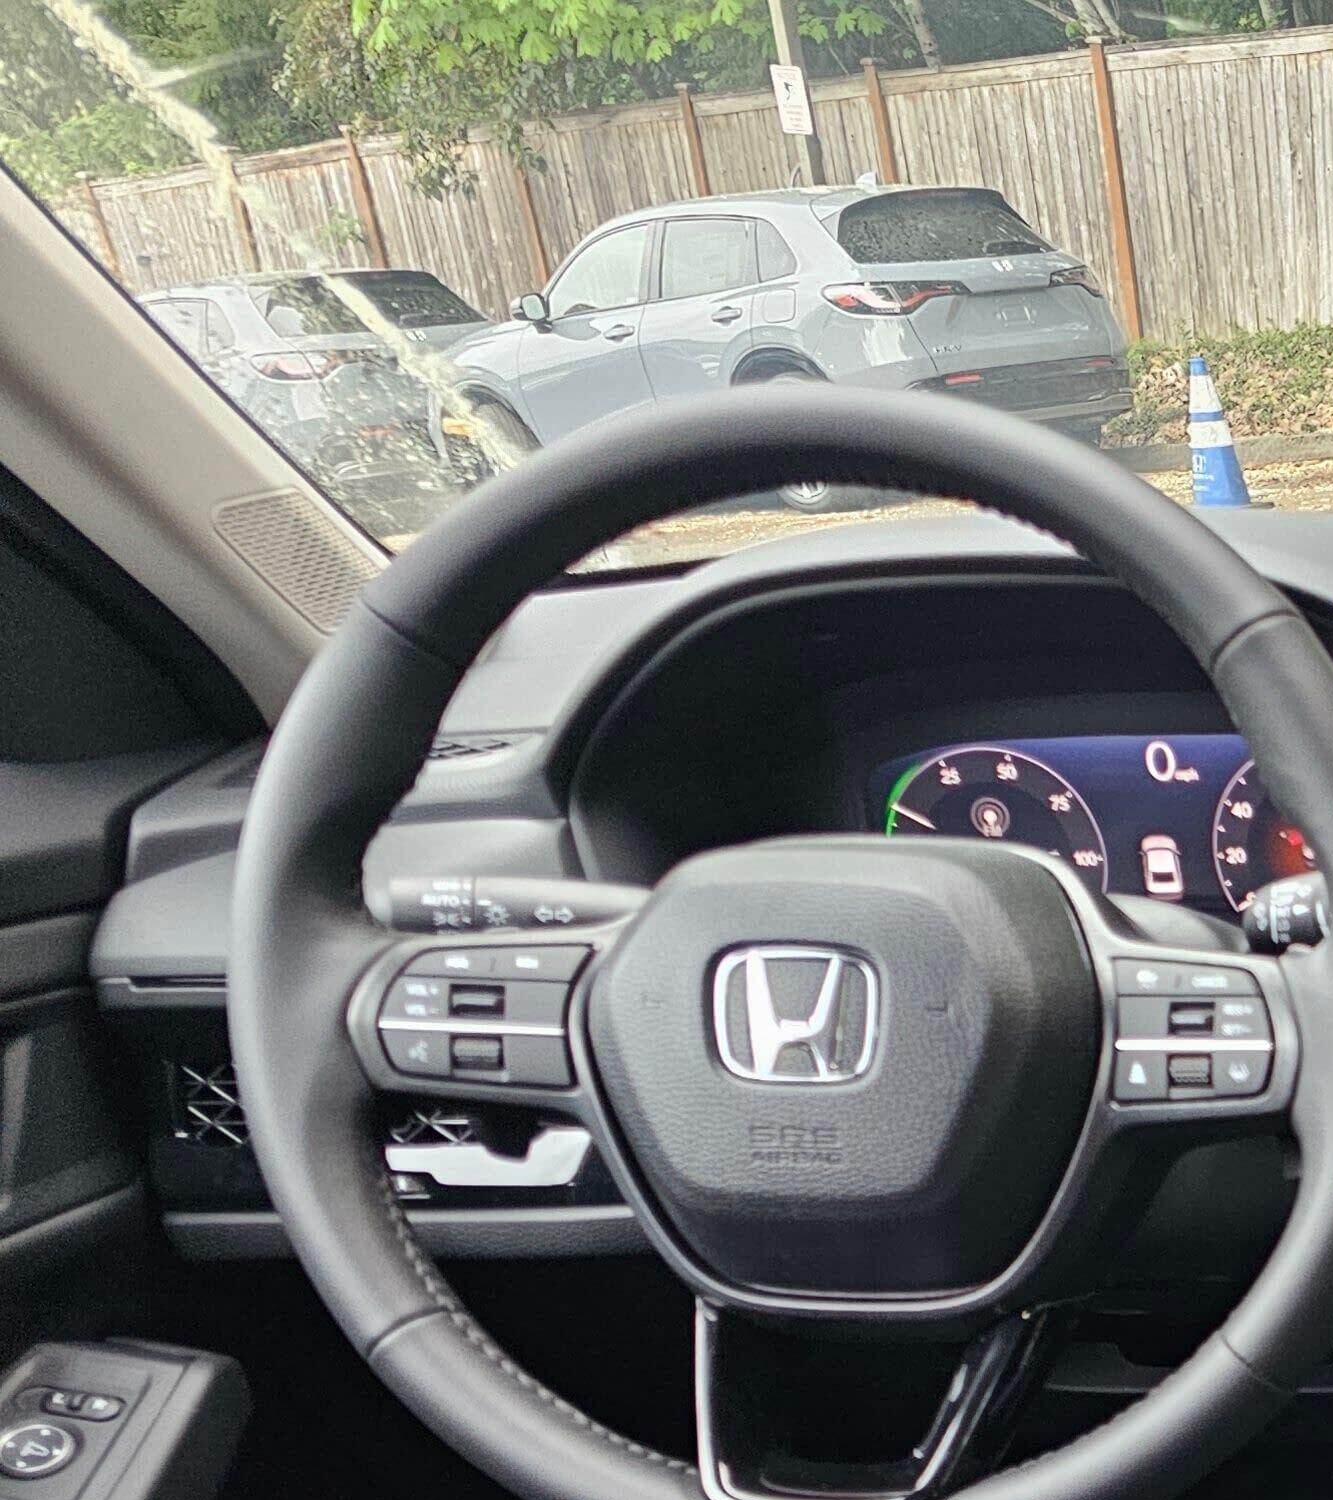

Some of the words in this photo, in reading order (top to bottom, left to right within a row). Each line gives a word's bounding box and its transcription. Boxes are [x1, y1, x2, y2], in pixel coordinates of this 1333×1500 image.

[1146, 740, 1176, 782] 0
[940, 767, 962, 786] 25
[996, 761, 1019, 782] 50
[1048, 794, 1071, 813] 75
[1230, 801, 1253, 820] 40
[1073, 850, 1098, 867] 100
